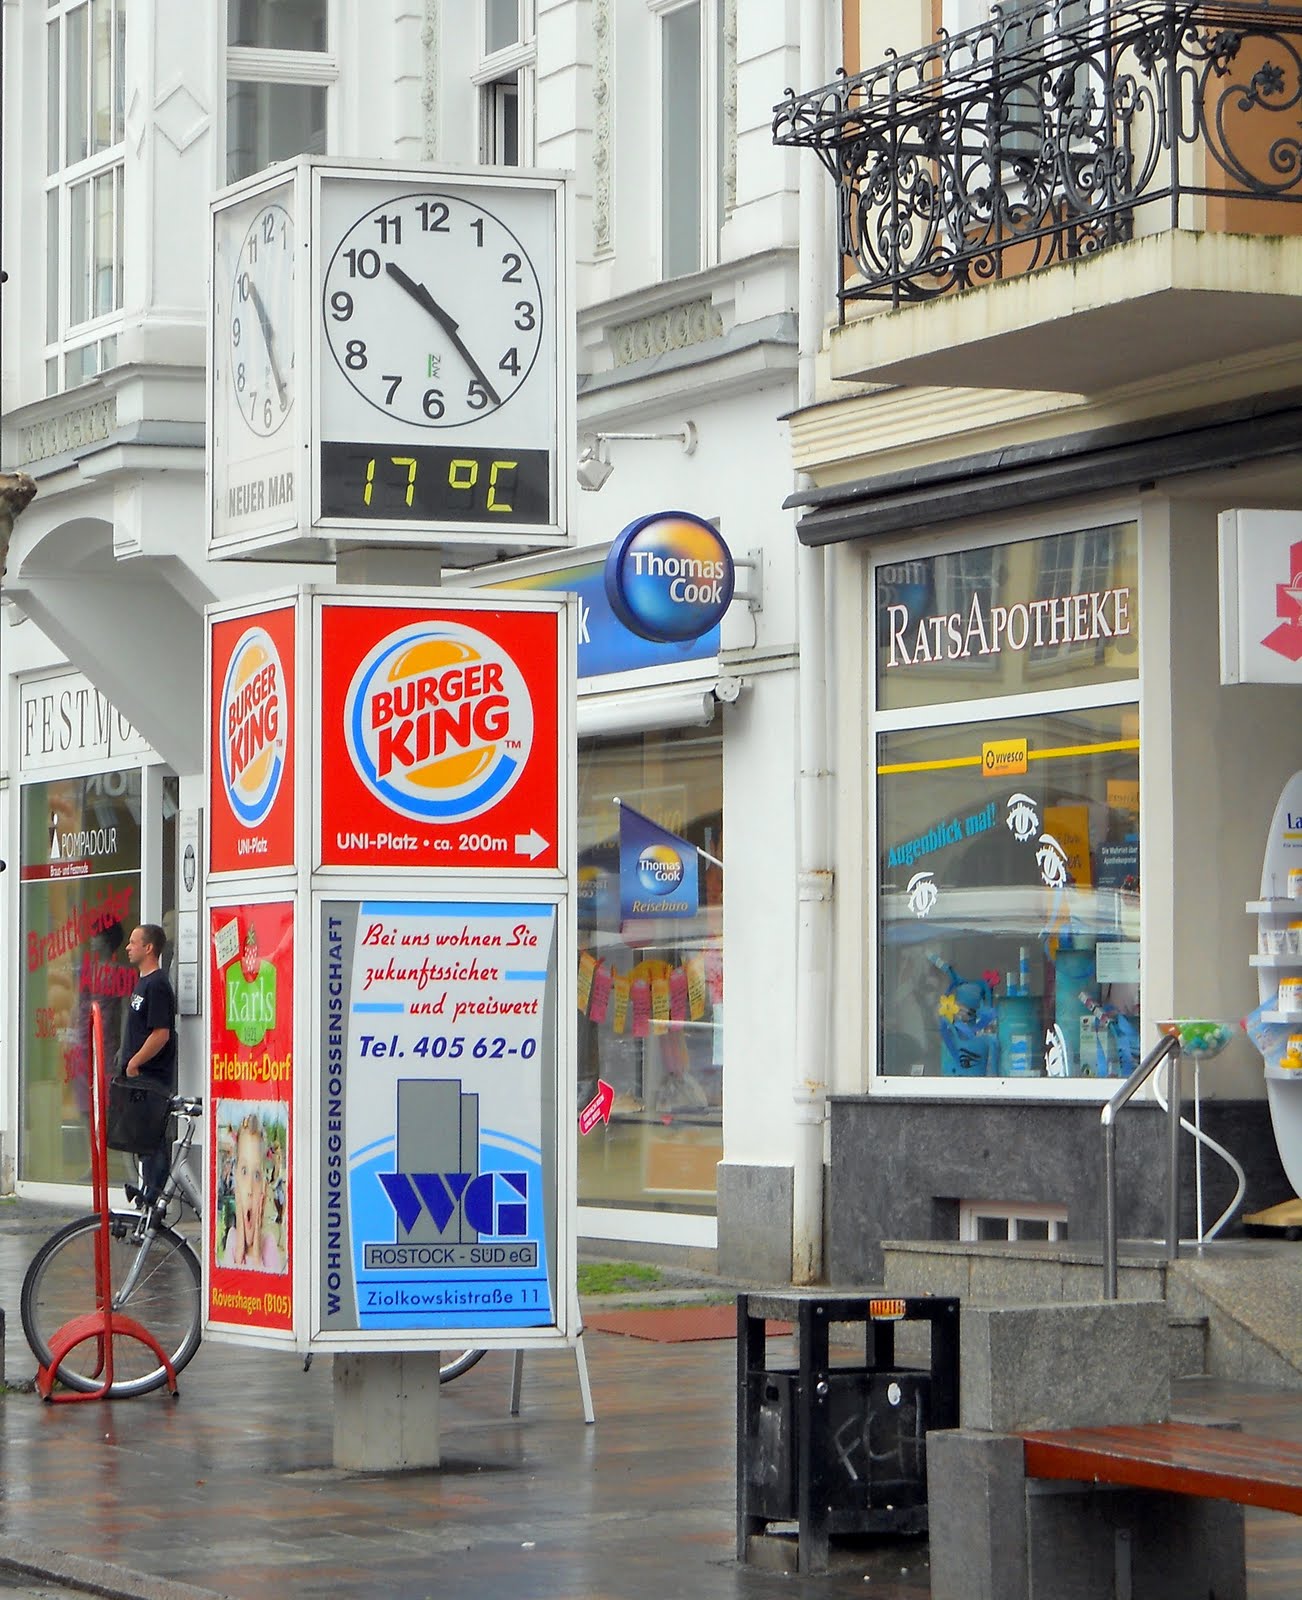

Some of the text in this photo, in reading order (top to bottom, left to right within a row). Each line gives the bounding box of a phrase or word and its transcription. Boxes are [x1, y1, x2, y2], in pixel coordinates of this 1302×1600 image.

[261, 213, 275, 245] 12
[373, 214, 402, 245] 11
[415, 202, 450, 233] 12
[470, 218, 484, 248] 1
[247, 234, 258, 265] 11
[342, 248, 381, 280] 10
[501, 253, 522, 284] 2
[236, 271, 251, 303] 10
[330, 290, 354, 322] 9
[514, 301, 536, 332] 3
[232, 317, 241, 348] 9
[345, 339, 368, 371] 8
[498, 347, 522, 377] 4
[236, 362, 246, 393] 8
[381, 374, 403, 406] 7
[249, 390, 259, 422] 7
[422, 388, 446, 420] 6
[466, 379, 488, 411] 5
[262, 398, 273, 429] 6
[228, 472, 294, 519] NEUER MAR
[363, 457, 417, 507] 17
[630, 551, 725, 580] Thomas
[669, 578, 723, 604] Cook
[228, 662, 277, 739] BURGER
[371, 662, 504, 730] BURGER
[229, 695, 280, 786] KING
[376, 694, 511, 778] KING
[995, 751, 1024, 764] vivesco
[60, 826, 118, 859] POMPADOUR
[237, 836, 268, 856] UNI-Platz
[336, 832, 508, 852] UNI-Platz ca. 200m
[887, 801, 997, 869] Augenblick mal!
[639, 859, 681, 871] Thomas
[654, 870, 681, 881] Cook
[361, 922, 539, 947] Bei uns wohnen Sie
[362, 957, 499, 991] zukunftssicher
[227, 976, 274, 1022] Karls
[409, 991, 539, 1024] und preiswert
[359, 1035, 537, 1059] Tel. 405 62-0
[212, 1052, 292, 1082] Erlebnis-Dorf
[326, 916, 343, 1316] WOHNUNGSGENOSSENSCHAFT
[370, 1248, 456, 1264] ROSTOCK
[469, 1247, 505, 1264] SÜD
[508, 1247, 532, 1263] eG
[263, 1293, 292, 1319] (B105)
[366, 1288, 539, 1306] Ziolkowskistraße 11
